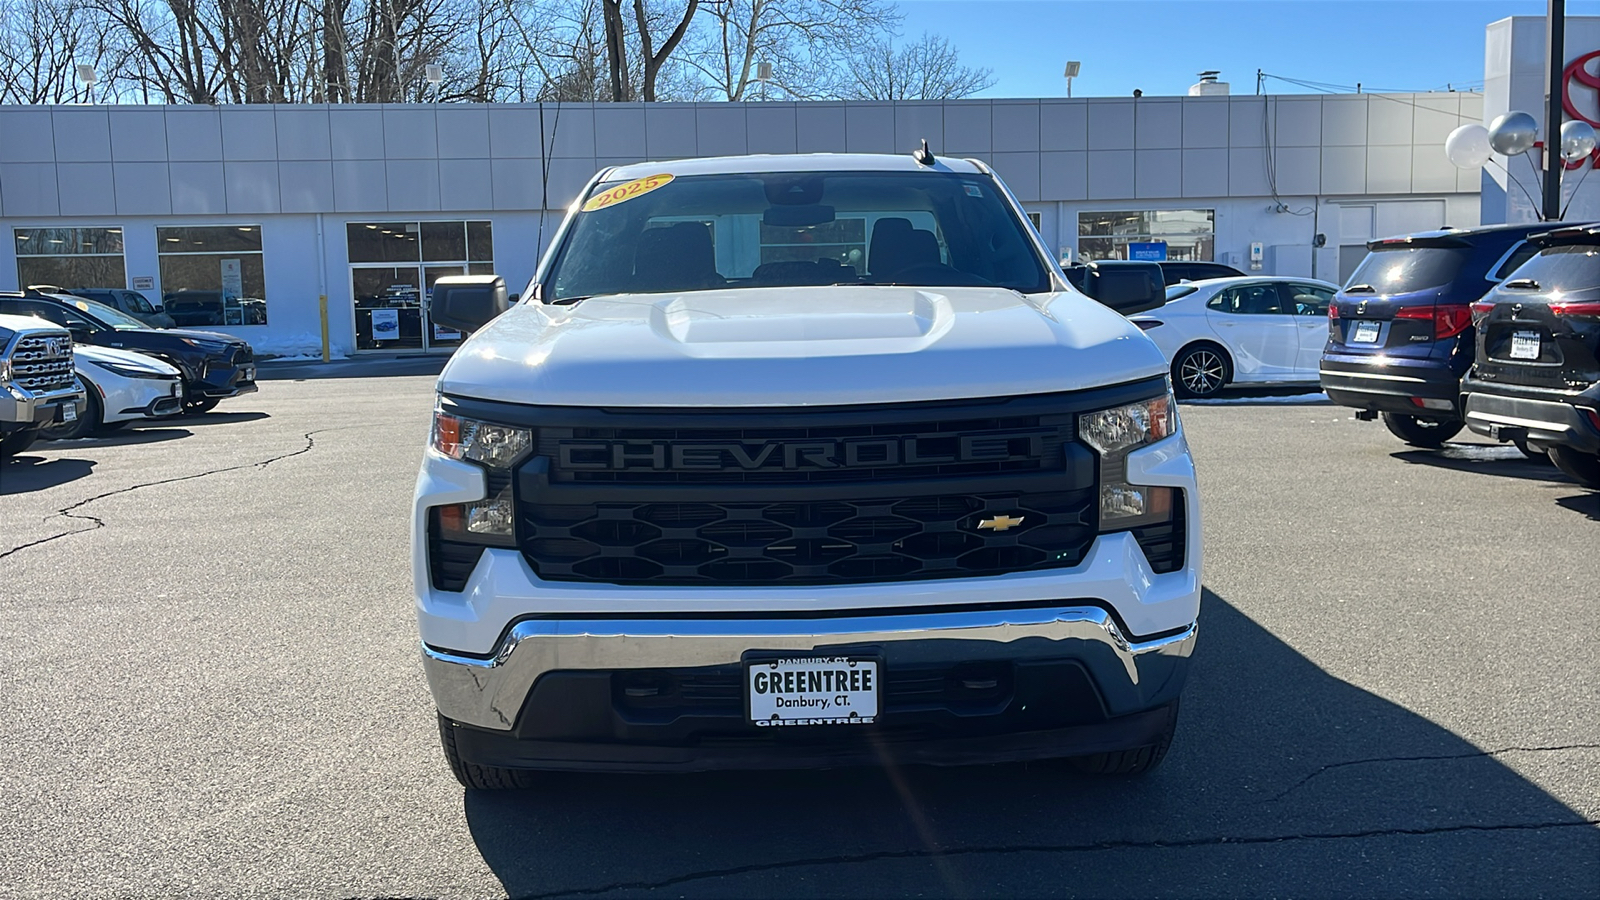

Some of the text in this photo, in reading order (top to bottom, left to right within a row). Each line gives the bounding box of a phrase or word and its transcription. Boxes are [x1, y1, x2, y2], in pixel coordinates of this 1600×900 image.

[598, 176, 659, 207] 2025
[559, 428, 1058, 471] CHEVROLET
[754, 669, 872, 694] GREENTREE
[776, 695, 851, 709] Danbury, CT.
[755, 718, 874, 727] GREENTREE
